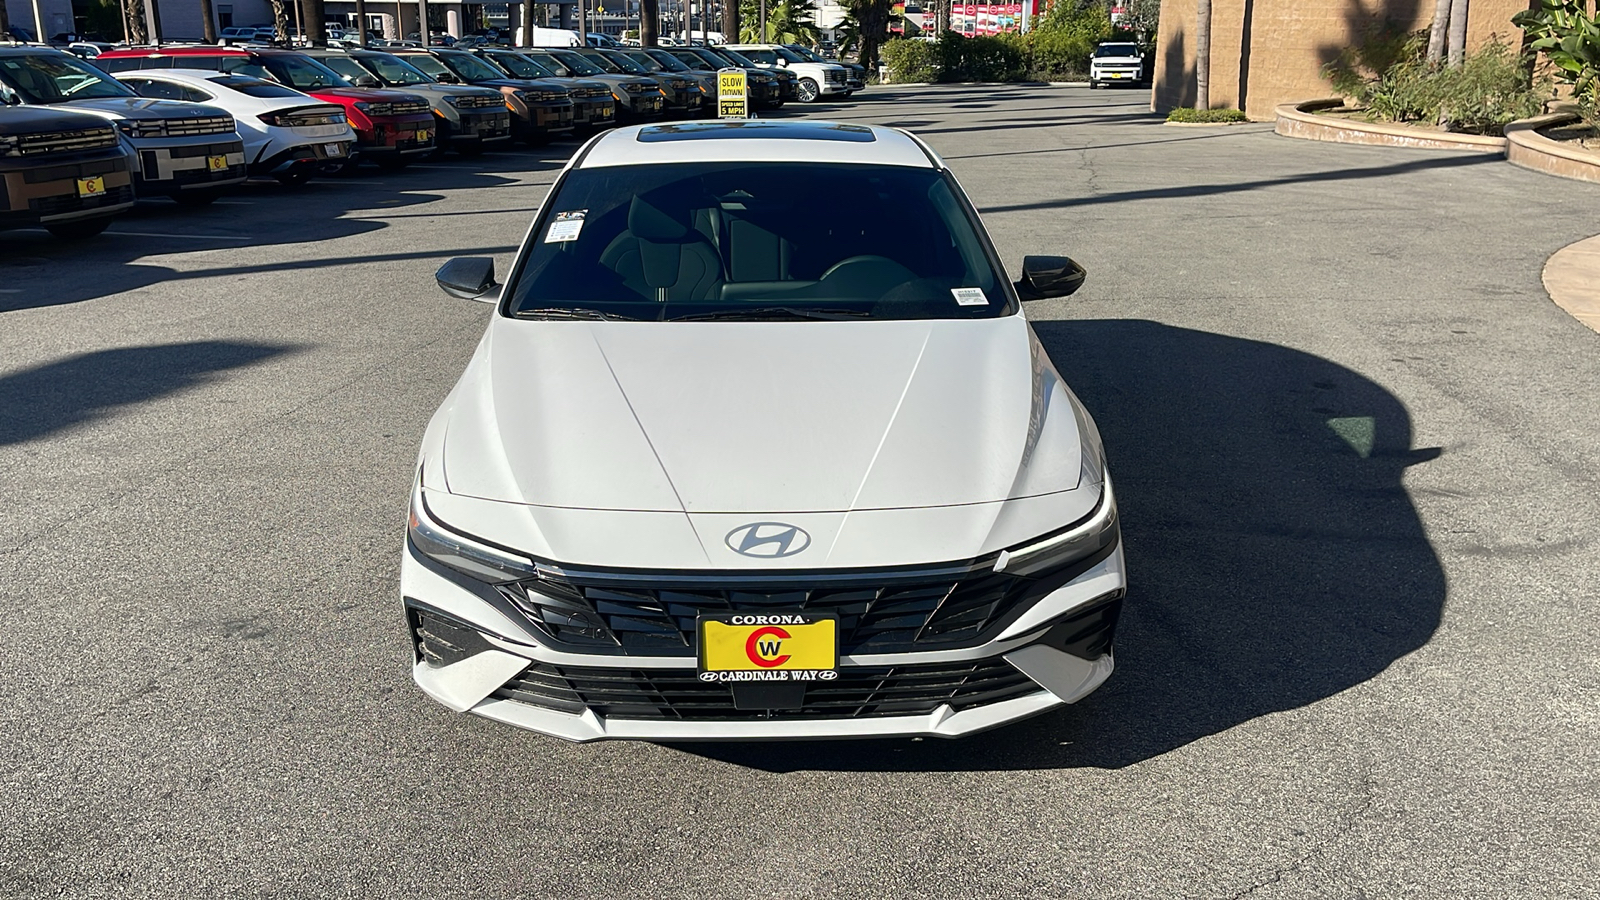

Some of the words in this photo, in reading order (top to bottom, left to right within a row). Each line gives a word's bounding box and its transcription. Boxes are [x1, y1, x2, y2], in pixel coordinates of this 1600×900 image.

[722, 77, 742, 87] SLOW
[731, 615, 805, 625] CORONA
[719, 671, 788, 681] CARDINALE
[791, 670, 818, 680] WAY
